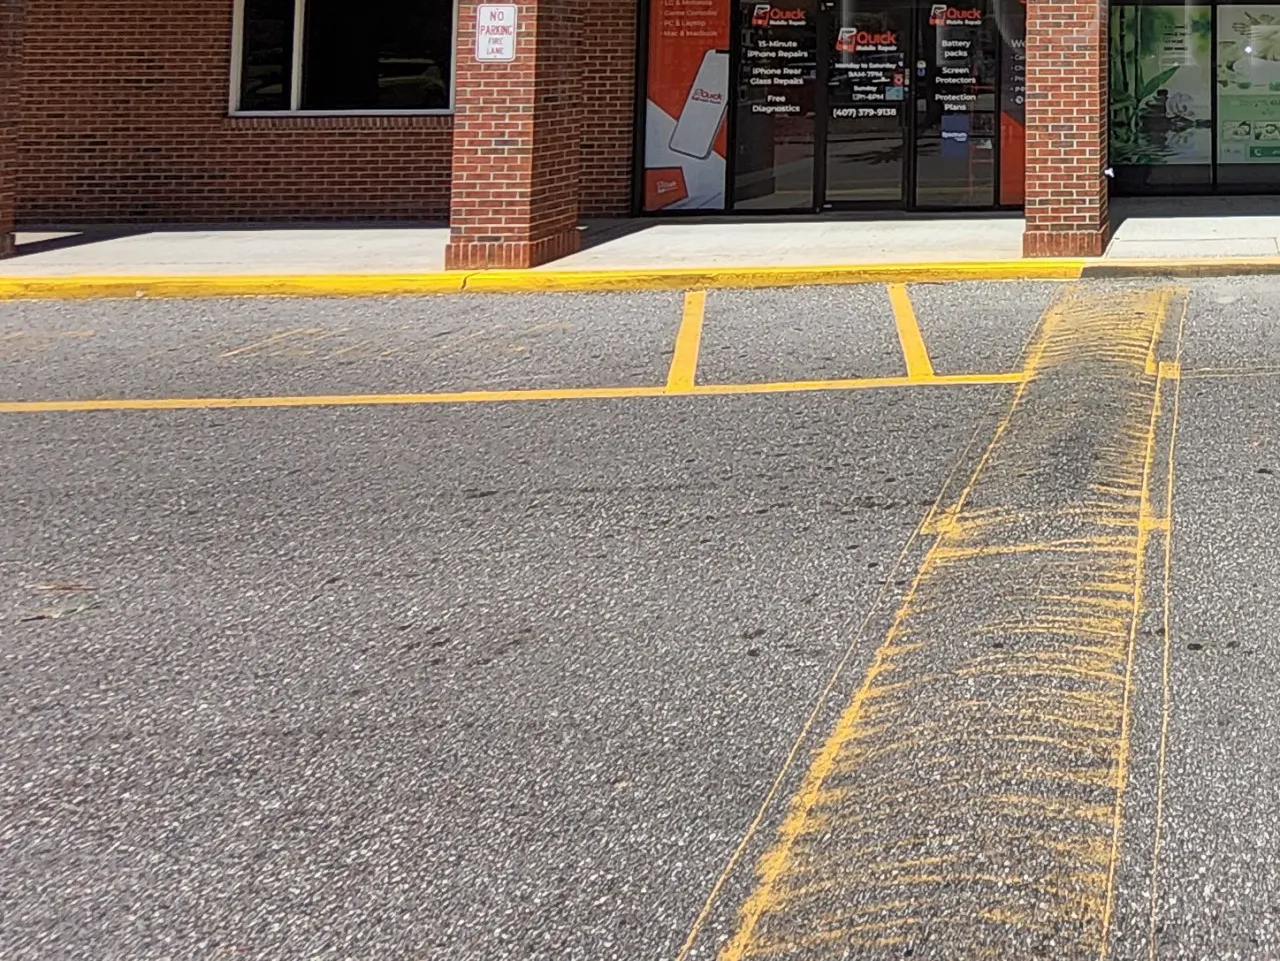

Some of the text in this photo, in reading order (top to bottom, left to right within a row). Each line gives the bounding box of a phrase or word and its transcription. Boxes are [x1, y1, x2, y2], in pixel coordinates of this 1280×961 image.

[489, 10, 505, 21] NO
[770, 8, 806, 19] Quick
[947, 7, 981, 19] Quick
[480, 25, 513, 35] PARKING
[857, 31, 897, 44] Quick
[942, 40, 971, 49] Battery
[747, 50, 808, 58] iPhone Repairs
[944, 50, 968, 58] packs
[750, 77, 804, 86] Glass Repairs
[767, 95, 786, 103] Free
[752, 105, 800, 114] Diagnostics
[944, 103, 967, 111] Plans
[832, 108, 897, 118] (407) 379-9138
